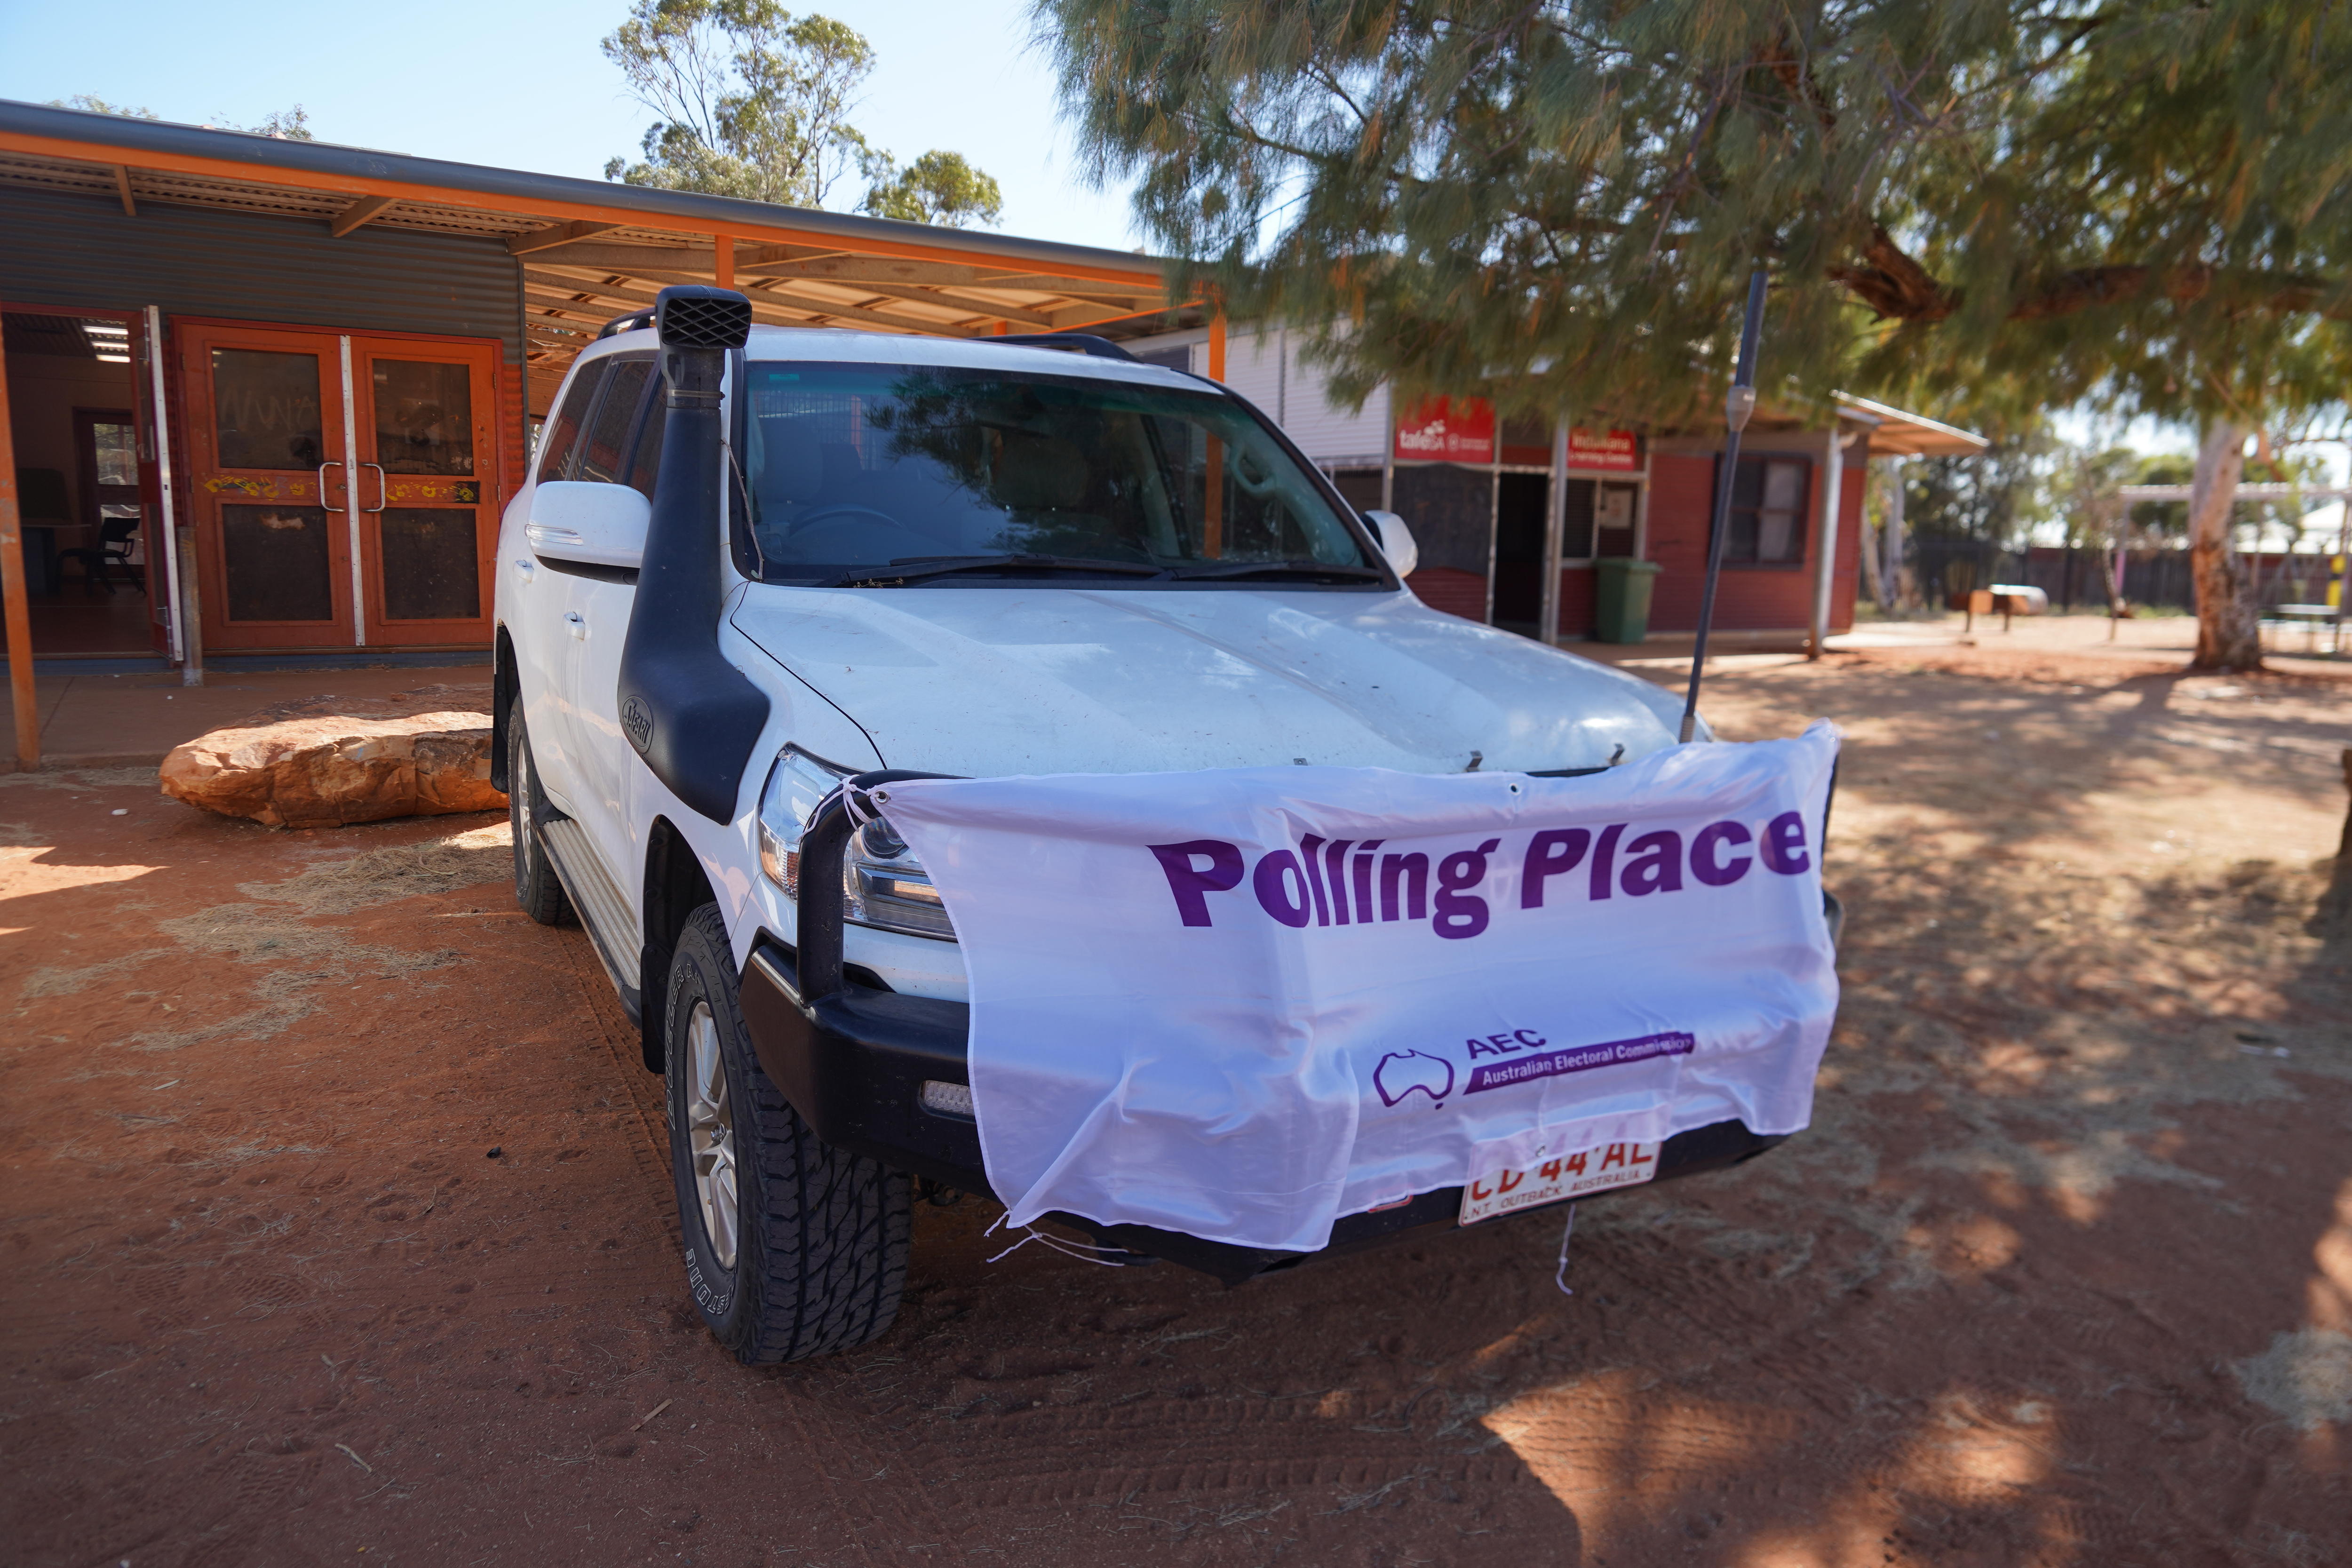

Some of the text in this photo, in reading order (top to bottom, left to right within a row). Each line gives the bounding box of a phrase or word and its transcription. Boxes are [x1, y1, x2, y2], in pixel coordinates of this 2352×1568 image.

[624, 699, 651, 744] SAFARI
[1145, 809, 1811, 940] Polling Place
[1466, 1029, 1547, 1059] AEC
[1482, 1059, 1552, 1086] Australian
[1555, 1046, 1613, 1070] Electoral
[1500, 1187, 1562, 1208] OUTBACK
[1571, 1170, 1640, 1191] AUSTRALIA
